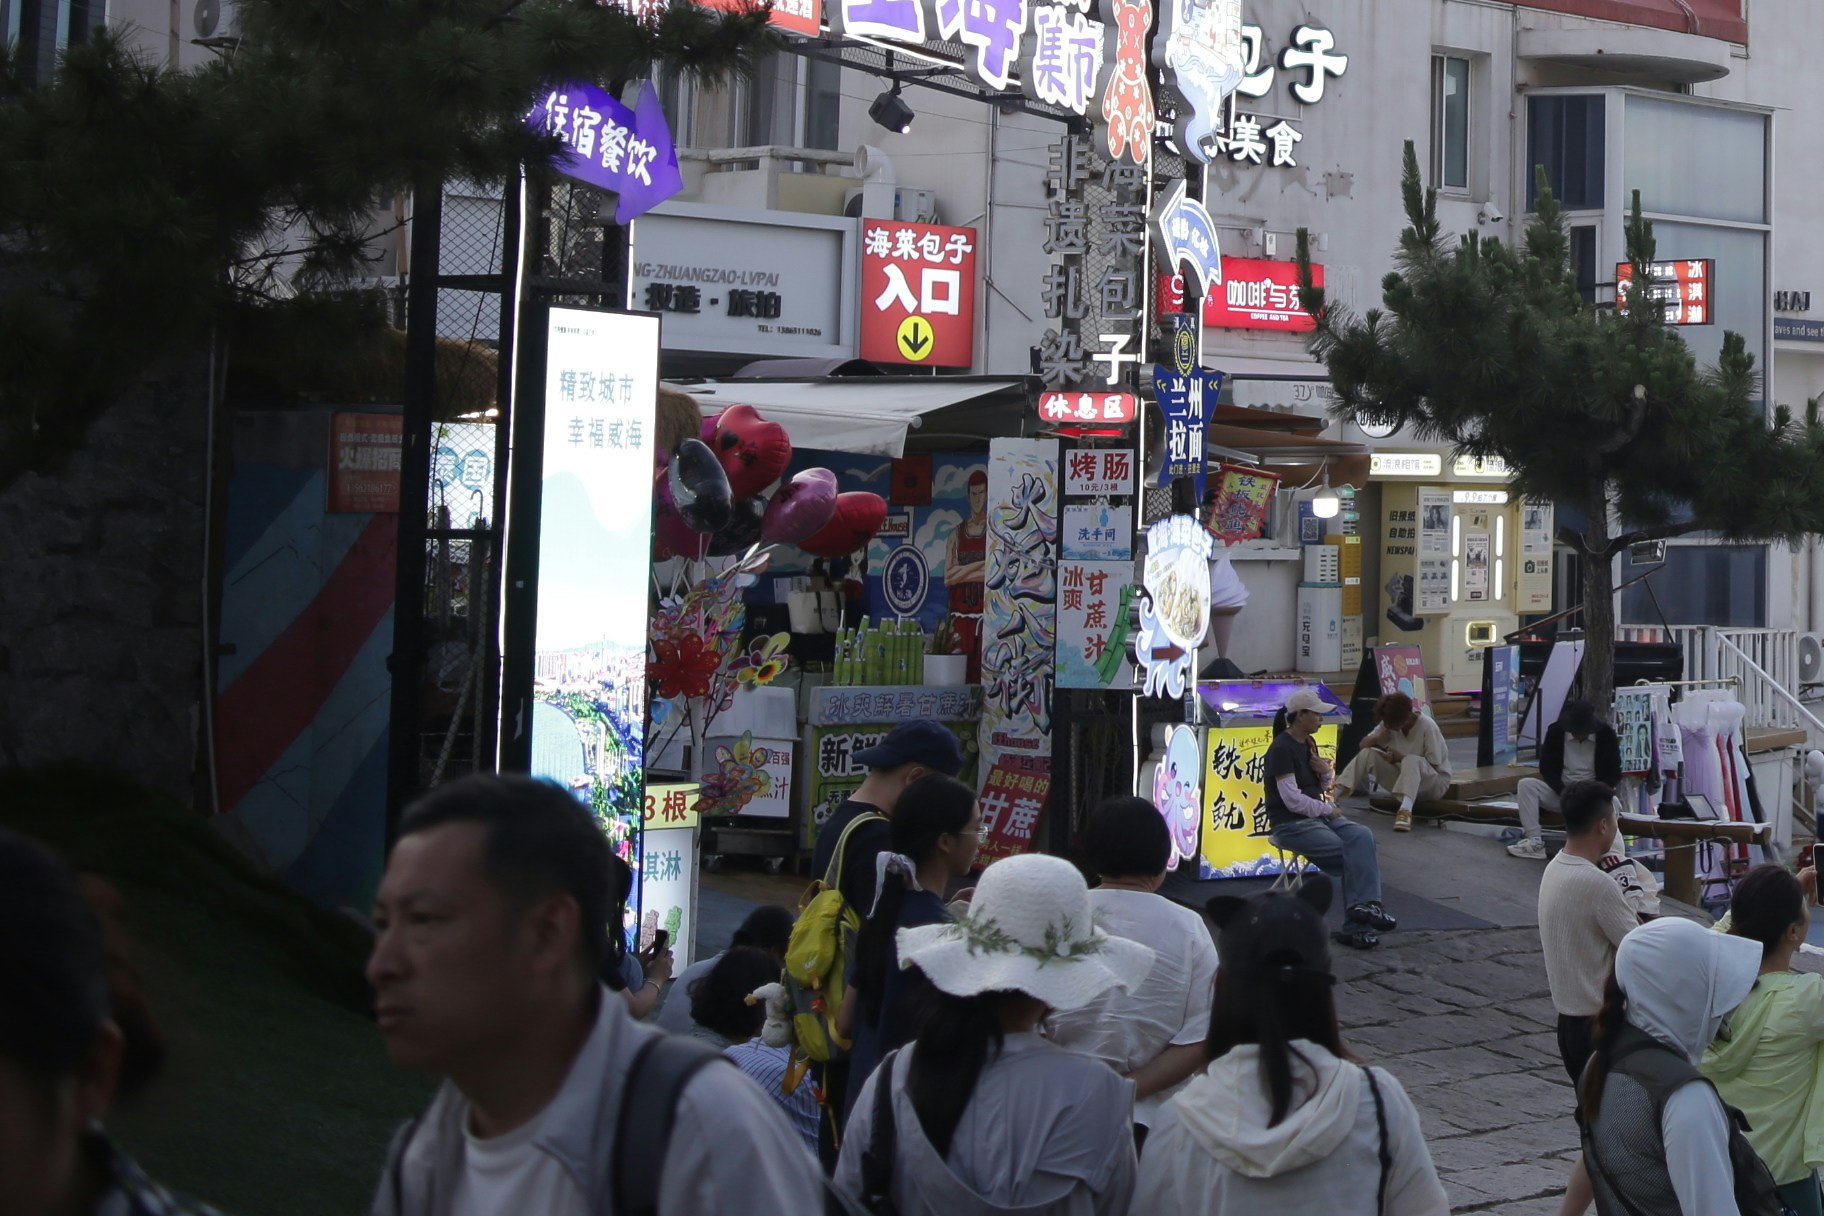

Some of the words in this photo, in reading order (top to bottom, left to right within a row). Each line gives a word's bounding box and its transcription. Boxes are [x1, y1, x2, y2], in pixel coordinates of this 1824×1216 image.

[1037, 8, 1098, 113] 集市
[545, 90, 658, 187] 住宿餐饮
[864, 227, 974, 265] 海菜包子
[1040, 134, 1091, 384] 非遗扎染
[1093, 158, 1145, 385] 海菜包子
[875, 263, 962, 316] 入口
[1687, 261, 1704, 323] 冰淇淋
[1250, 312, 1268, 321] COFFEE
[1269, 313, 1280, 322] AND
[1280, 314, 1289, 322] TEA
[1792, 324, 1806, 336] and
[1807, 327, 1819, 336] see
[559, 368, 634, 405] 精致城市
[1169, 377, 1203, 420] 兰州
[1044, 393, 1125, 420] 休息区
[567, 416, 643, 450] 幸福威海
[1168, 420, 1203, 463] 拉面
[1069, 452, 1130, 482] 烤肠
[1382, 459, 1421, 471] 流浪相馆
[1079, 482, 1119, 492] 10元/3根
[1388, 510, 1416, 522] 旧报纸
[1388, 527, 1416, 539] 自助拍
[1077, 527, 1117, 542] 洗手间
[1062, 566, 1084, 611] 冰爽
[1082, 569, 1109, 661] 甘蔗汁
[829, 691, 978, 717] 冰爽解暑甘蔗汁
[987, 769, 1049, 797] 最好喝的
[978, 790, 1042, 840] 甘蔗
[1620, 875, 1629, 888] 3
